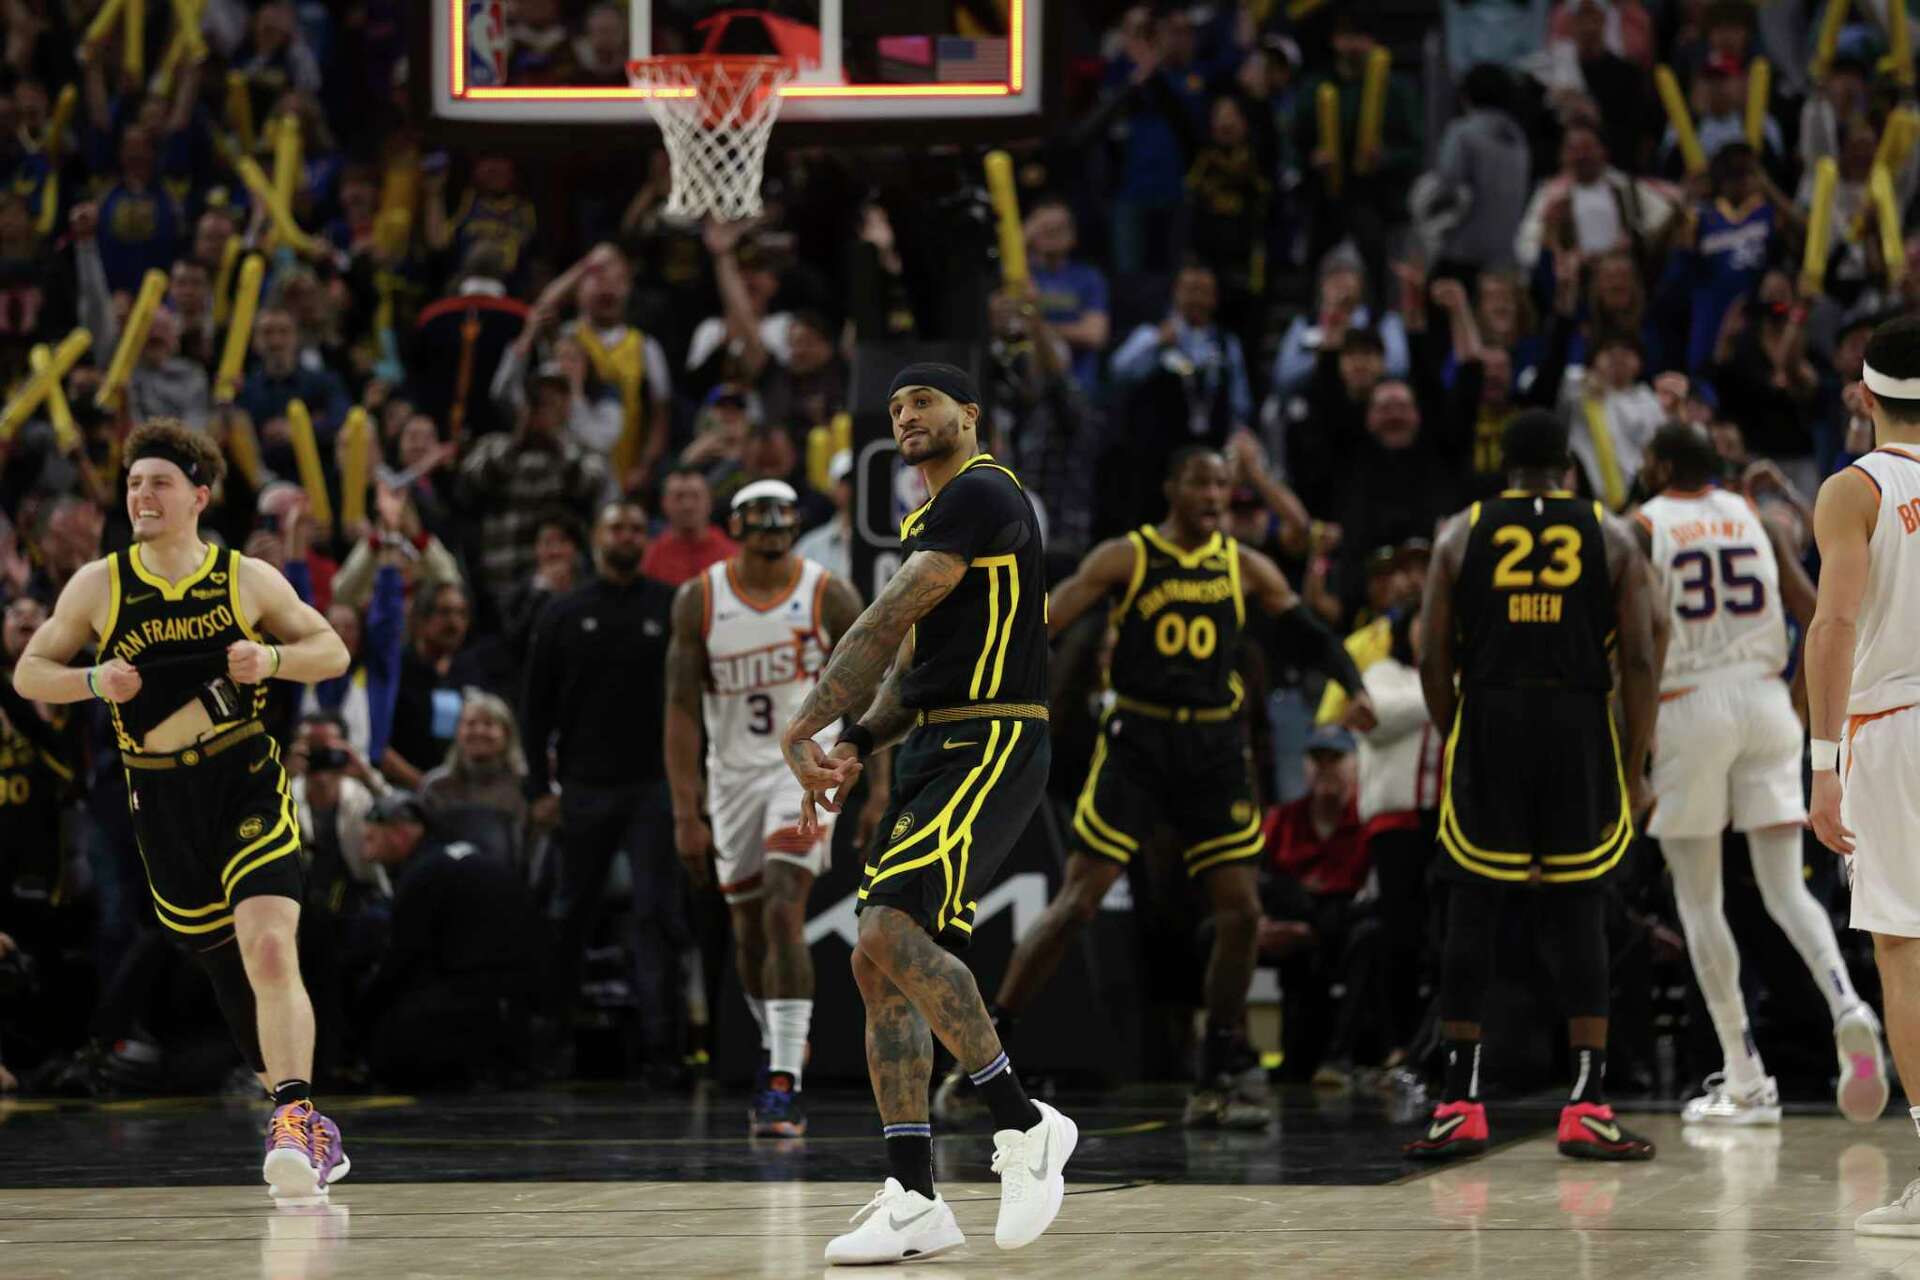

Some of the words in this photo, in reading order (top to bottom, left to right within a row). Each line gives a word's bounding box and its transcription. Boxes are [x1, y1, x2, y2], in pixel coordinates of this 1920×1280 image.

[1492, 523, 1582, 588] 23
[1508, 593, 1563, 623] GREEN
[1671, 546, 1765, 620] 35
[113, 629, 147, 662] SAN
[141, 604, 233, 645] FRANCISCO
[1156, 611, 1217, 659] 00
[747, 693, 774, 736] 3
